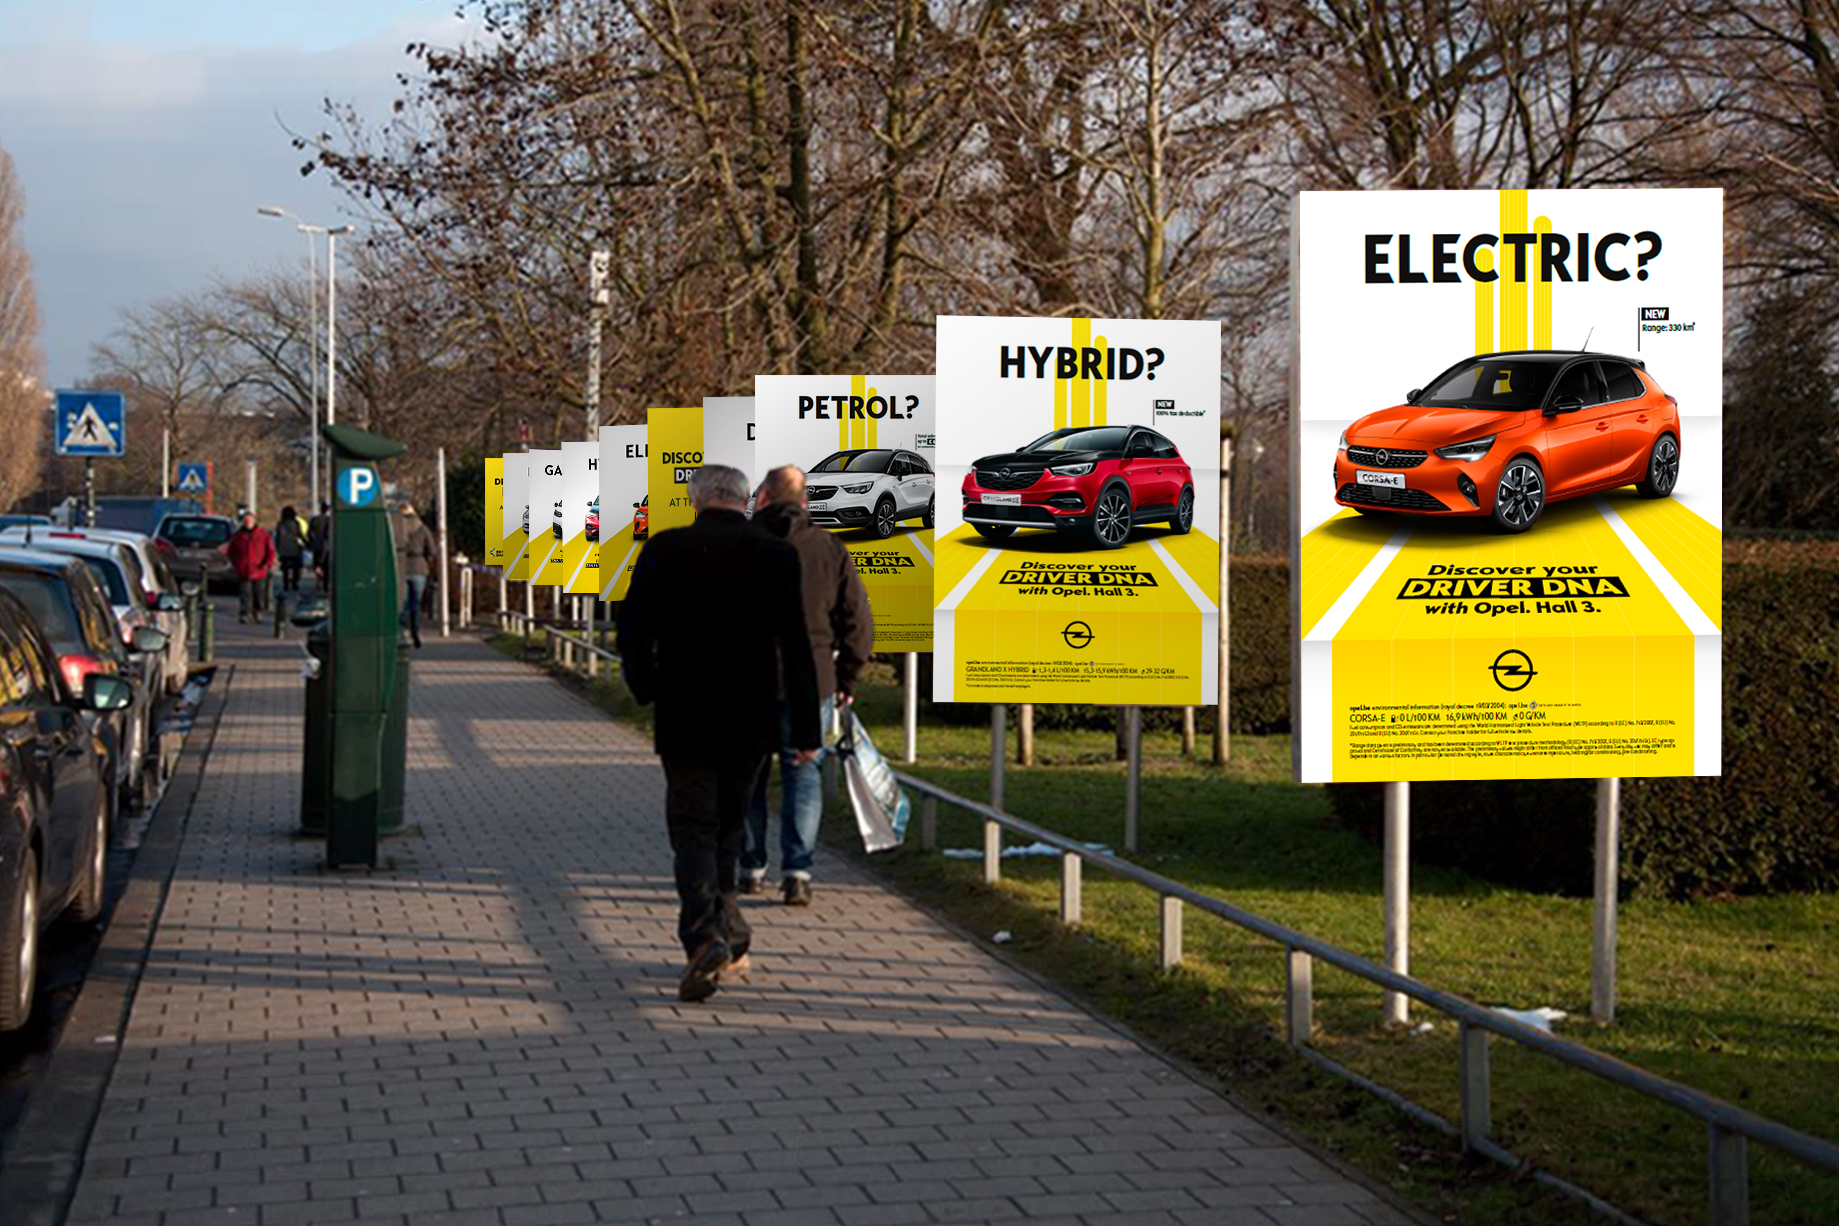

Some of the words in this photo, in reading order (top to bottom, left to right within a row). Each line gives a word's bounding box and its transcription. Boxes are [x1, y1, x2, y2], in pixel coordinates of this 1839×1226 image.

[1364, 230, 1663, 284] ELECTRIC?
[1643, 308, 1667, 319] NEW
[1642, 323, 1668, 334] Range:
[1668, 323, 1683, 332] 330
[1000, 345, 1165, 381] HYBRID?
[798, 395, 920, 420] PETROL?
[1156, 400, 1174, 408] NEW
[662, 451, 704, 464] DISCO
[1362, 473, 1399, 485] CORSA-E
[350, 468, 373, 504] P
[872, 557, 912, 566] DNA
[1020, 561, 1094, 571] Discover
[1099, 563, 1137, 572] your
[869, 567, 889, 575] Hall
[891, 567, 901, 575] 3.
[1427, 563, 1536, 576] Discover
[1542, 565, 1598, 577] your
[1003, 571, 1093, 584] DRIVER
[1098, 573, 1154, 585] DNA
[1018, 586, 1048, 595] with
[1052, 587, 1091, 597] Opel.
[1094, 587, 1122, 597] Hall
[1125, 587, 1139, 597] 3.
[1402, 579, 1534, 597] DRIVER
[1541, 578, 1624, 596] DNA
[1425, 602, 1468, 614] with
[1474, 601, 1530, 617] Opel.
[1536, 601, 1576, 614] Hall
[1582, 601, 1601, 613] 3.
[1350, 704, 1370, 712] opel.be
[1372, 703, 1409, 711] environmental
[1508, 701, 1528, 710] opel.be
[1349, 713, 1386, 723] CORSA-E
[1406, 713, 1427, 722] L/100
[1427, 713, 1441, 721] KM
[1446, 712, 1460, 722] 16,9
[1461, 712, 1494, 721] kWh/100
[1495, 711, 1507, 720] KM
[1525, 711, 1546, 720] G/KM
